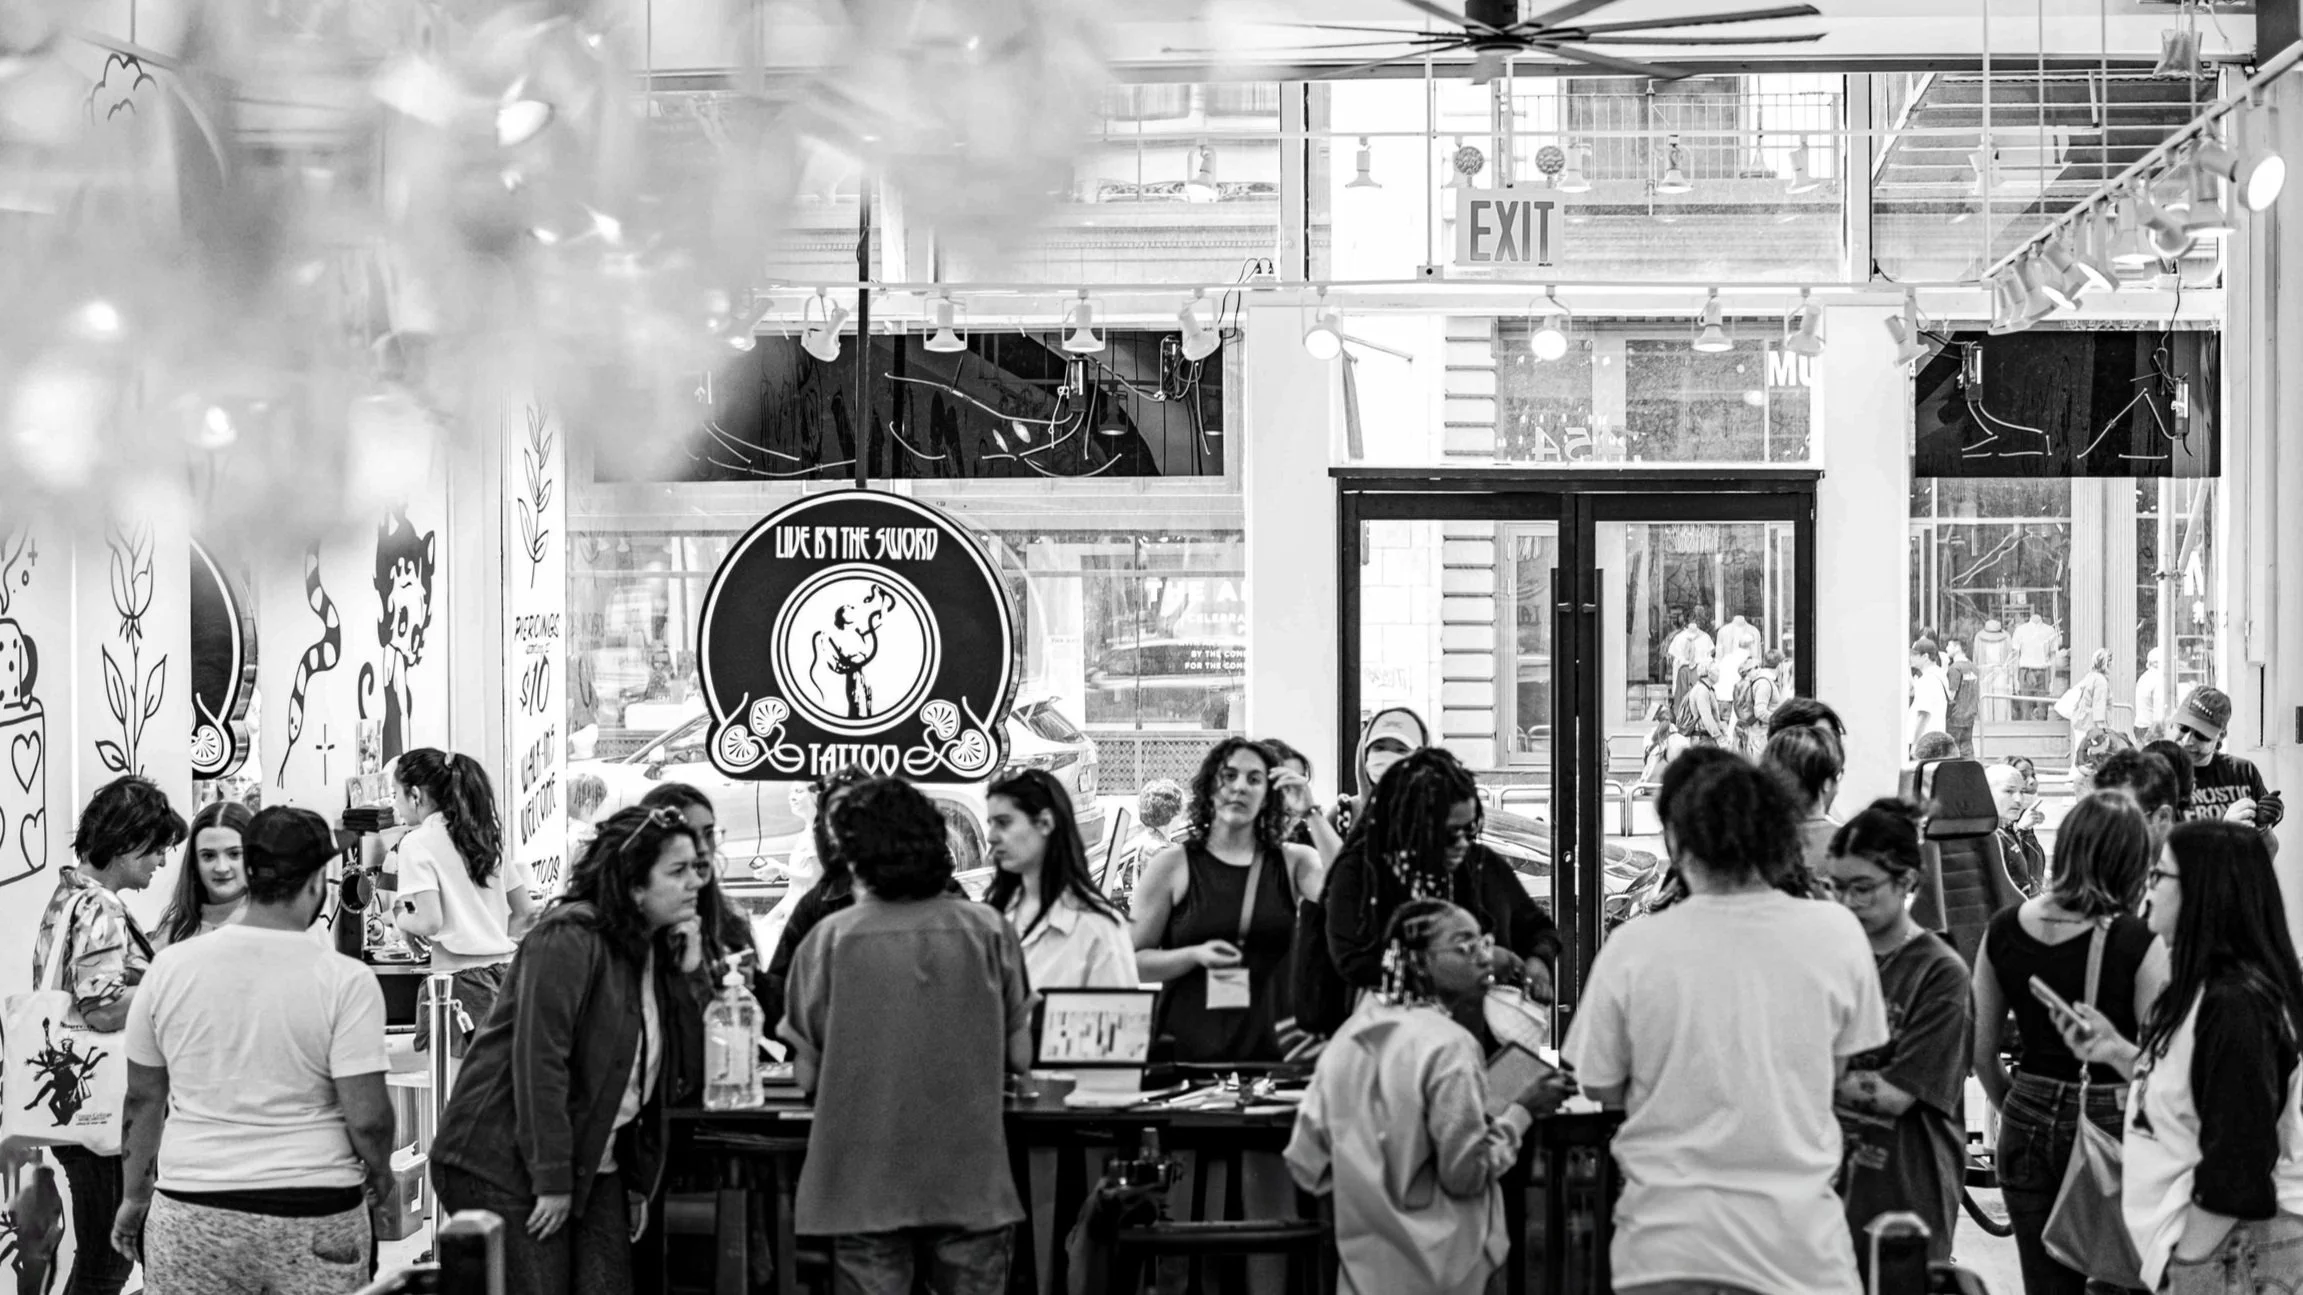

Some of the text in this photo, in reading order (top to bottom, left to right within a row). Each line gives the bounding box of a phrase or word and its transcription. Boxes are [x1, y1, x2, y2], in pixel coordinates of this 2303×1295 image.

[1470, 200, 1554, 262] EXIT
[775, 526, 939, 561] LIVE BY THE SWORD
[1144, 580, 1246, 602] THE A
[1185, 661, 1203, 670] FOR
[1205, 661, 1222, 670] THE
[1190, 649, 1246, 659] BY THE COM
[519, 655, 550, 717] $10
[808, 743, 900, 777] TATTOO
[521, 772, 556, 846] WELCOME
